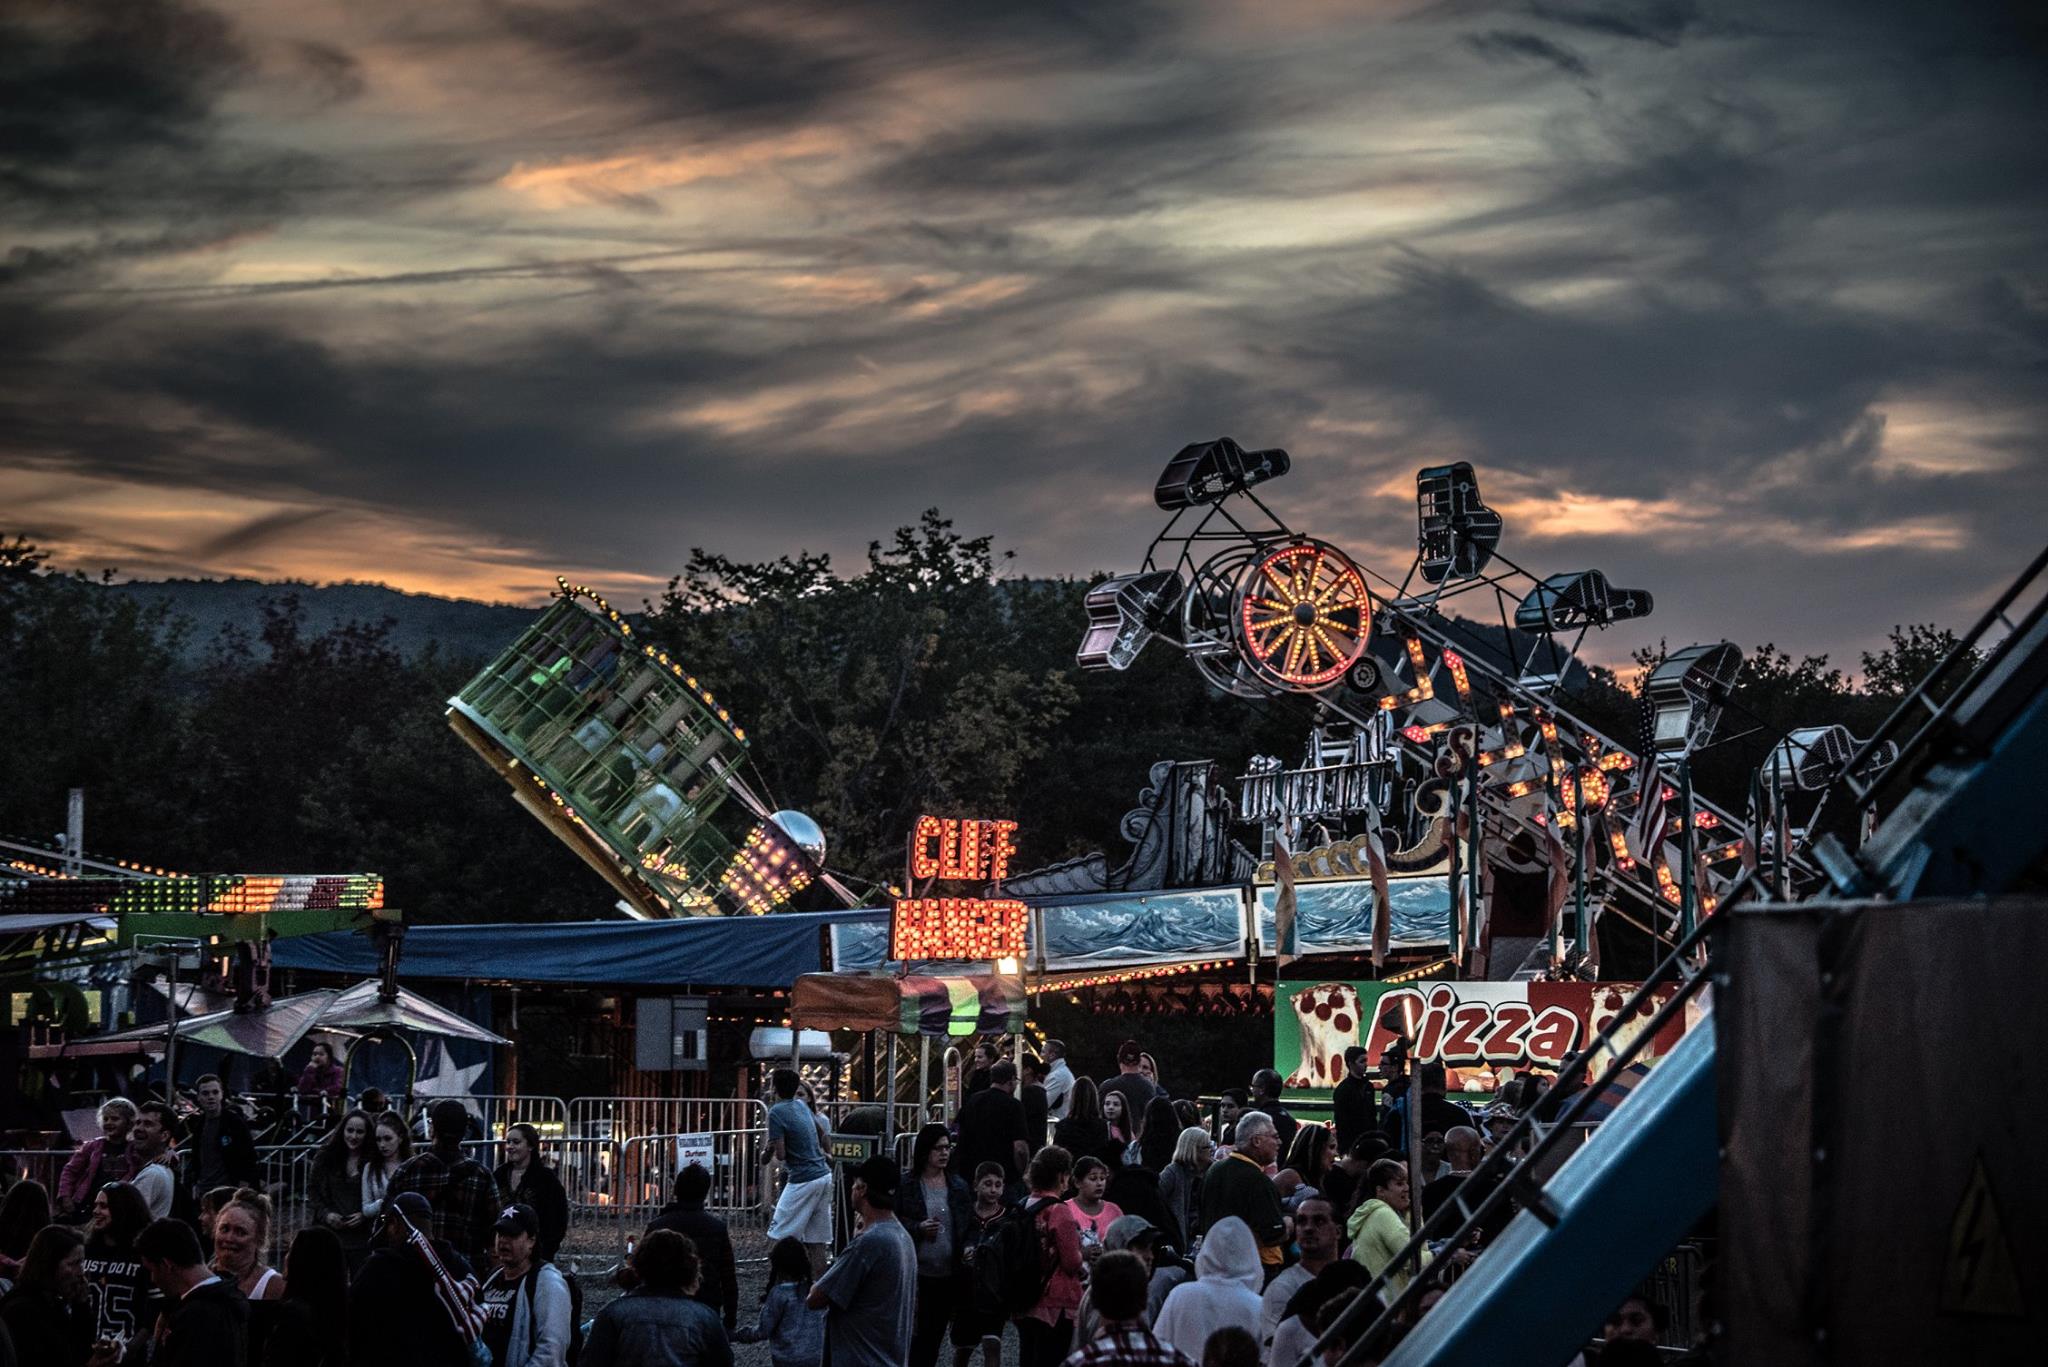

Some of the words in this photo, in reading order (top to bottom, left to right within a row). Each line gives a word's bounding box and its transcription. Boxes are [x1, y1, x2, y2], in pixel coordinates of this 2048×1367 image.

[912, 816, 1018, 880] CLIFF
[891, 898, 1029, 960] HANGER
[1365, 984, 1580, 1072] Pizza
[82, 1260, 108, 1274] UST
[108, 1262, 125, 1274] DO
[126, 1263, 140, 1277] IT
